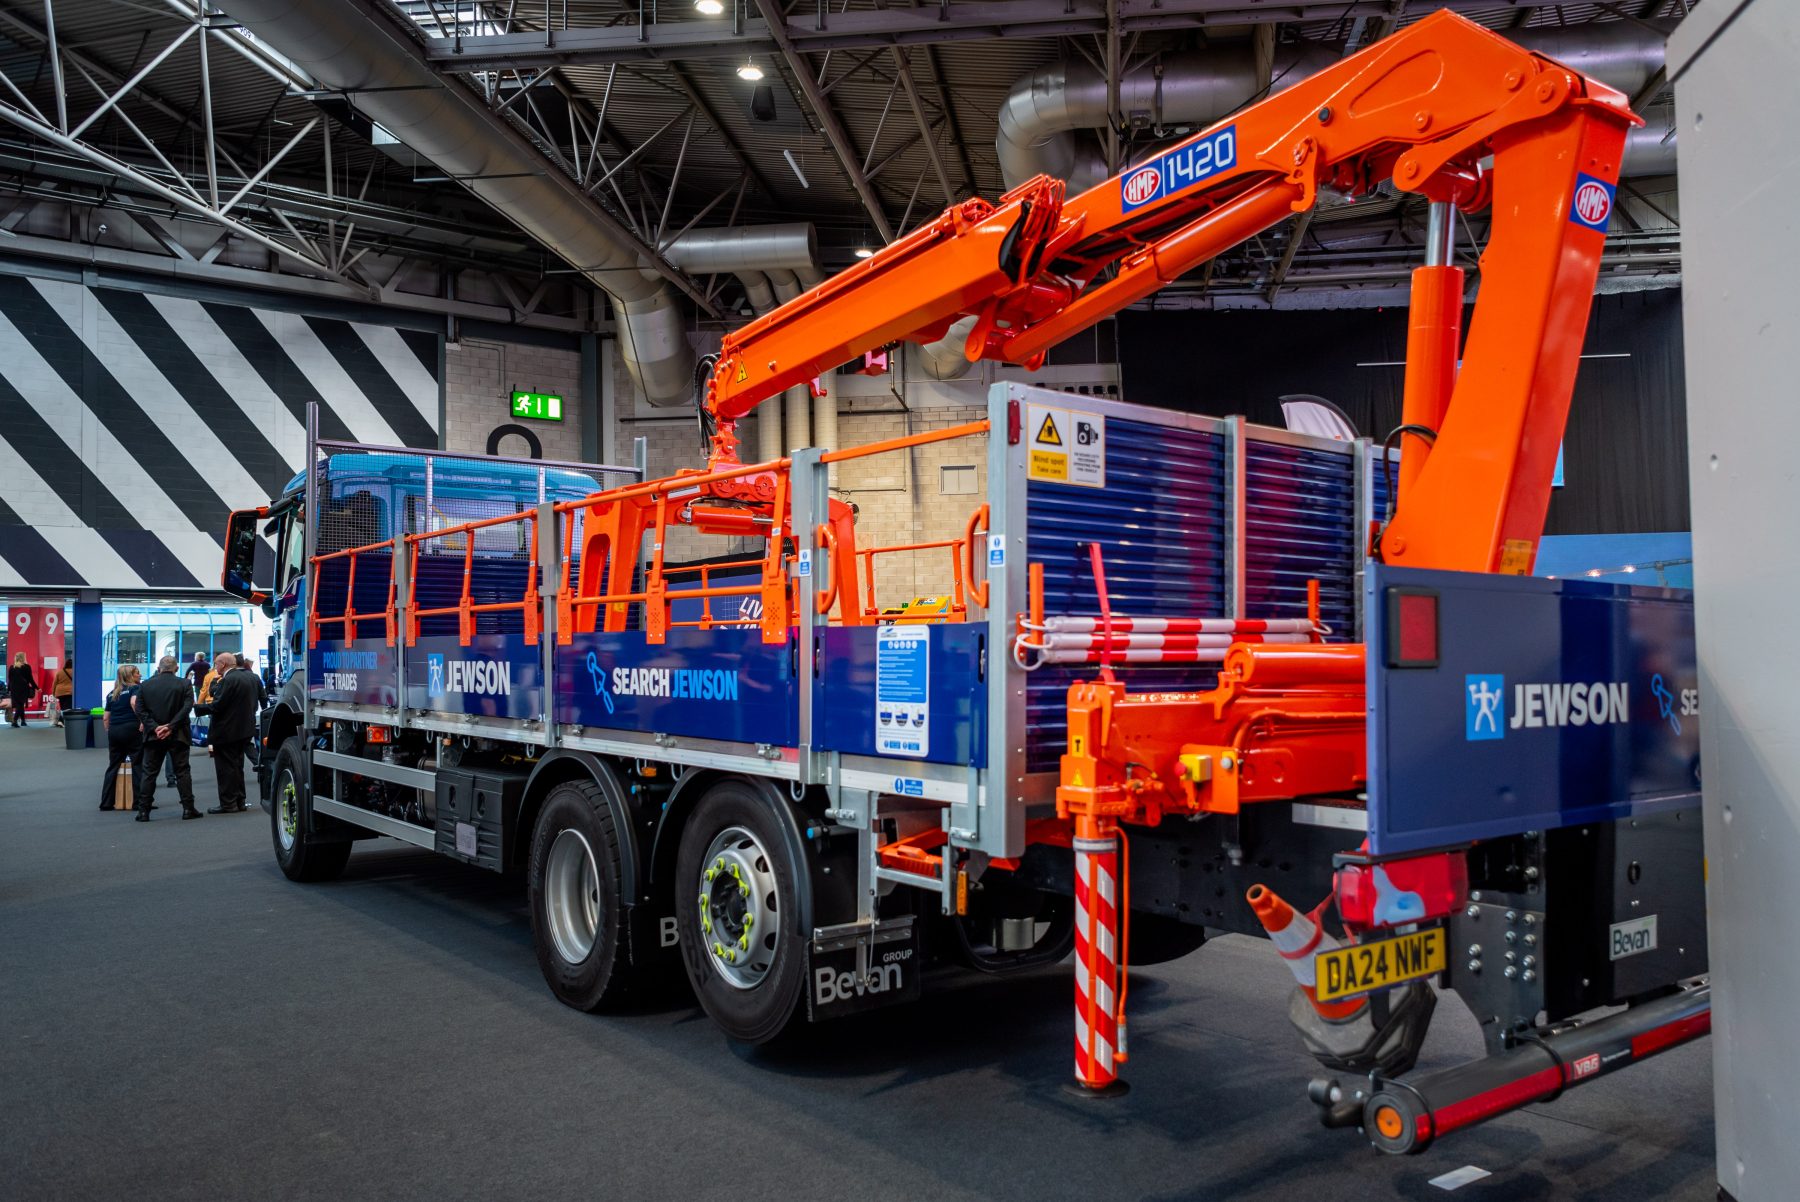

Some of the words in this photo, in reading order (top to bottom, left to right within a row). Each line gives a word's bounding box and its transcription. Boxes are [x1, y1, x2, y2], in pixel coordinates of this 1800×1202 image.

[1128, 171, 1156, 201] HMF
[1166, 132, 1234, 189] 1420
[1579, 187, 1607, 220] HMF
[739, 596, 763, 619] LIV
[15, 612, 31, 634] 9
[45, 612, 58, 634] 9
[323, 651, 341, 669] PROUD
[342, 652, 350, 669] TO
[350, 652, 377, 670] PARTNER
[324, 673, 334, 690] THE
[335, 673, 357, 691] TRADES
[446, 660, 511, 695] JEWSON
[612, 667, 670, 697] SEARCH
[672, 669, 738, 701] JEWSON
[1510, 682, 1629, 729] JEWSON
[1680, 688, 1700, 716] SE
[660, 916, 680, 947] B
[1613, 928, 1650, 956] Bevan
[883, 949, 913, 963] GROUP
[1327, 945, 1389, 994] DA24
[1395, 933, 1436, 977] NWF
[815, 962, 902, 1005] Bevan
[1575, 1057, 1599, 1075] VBG
